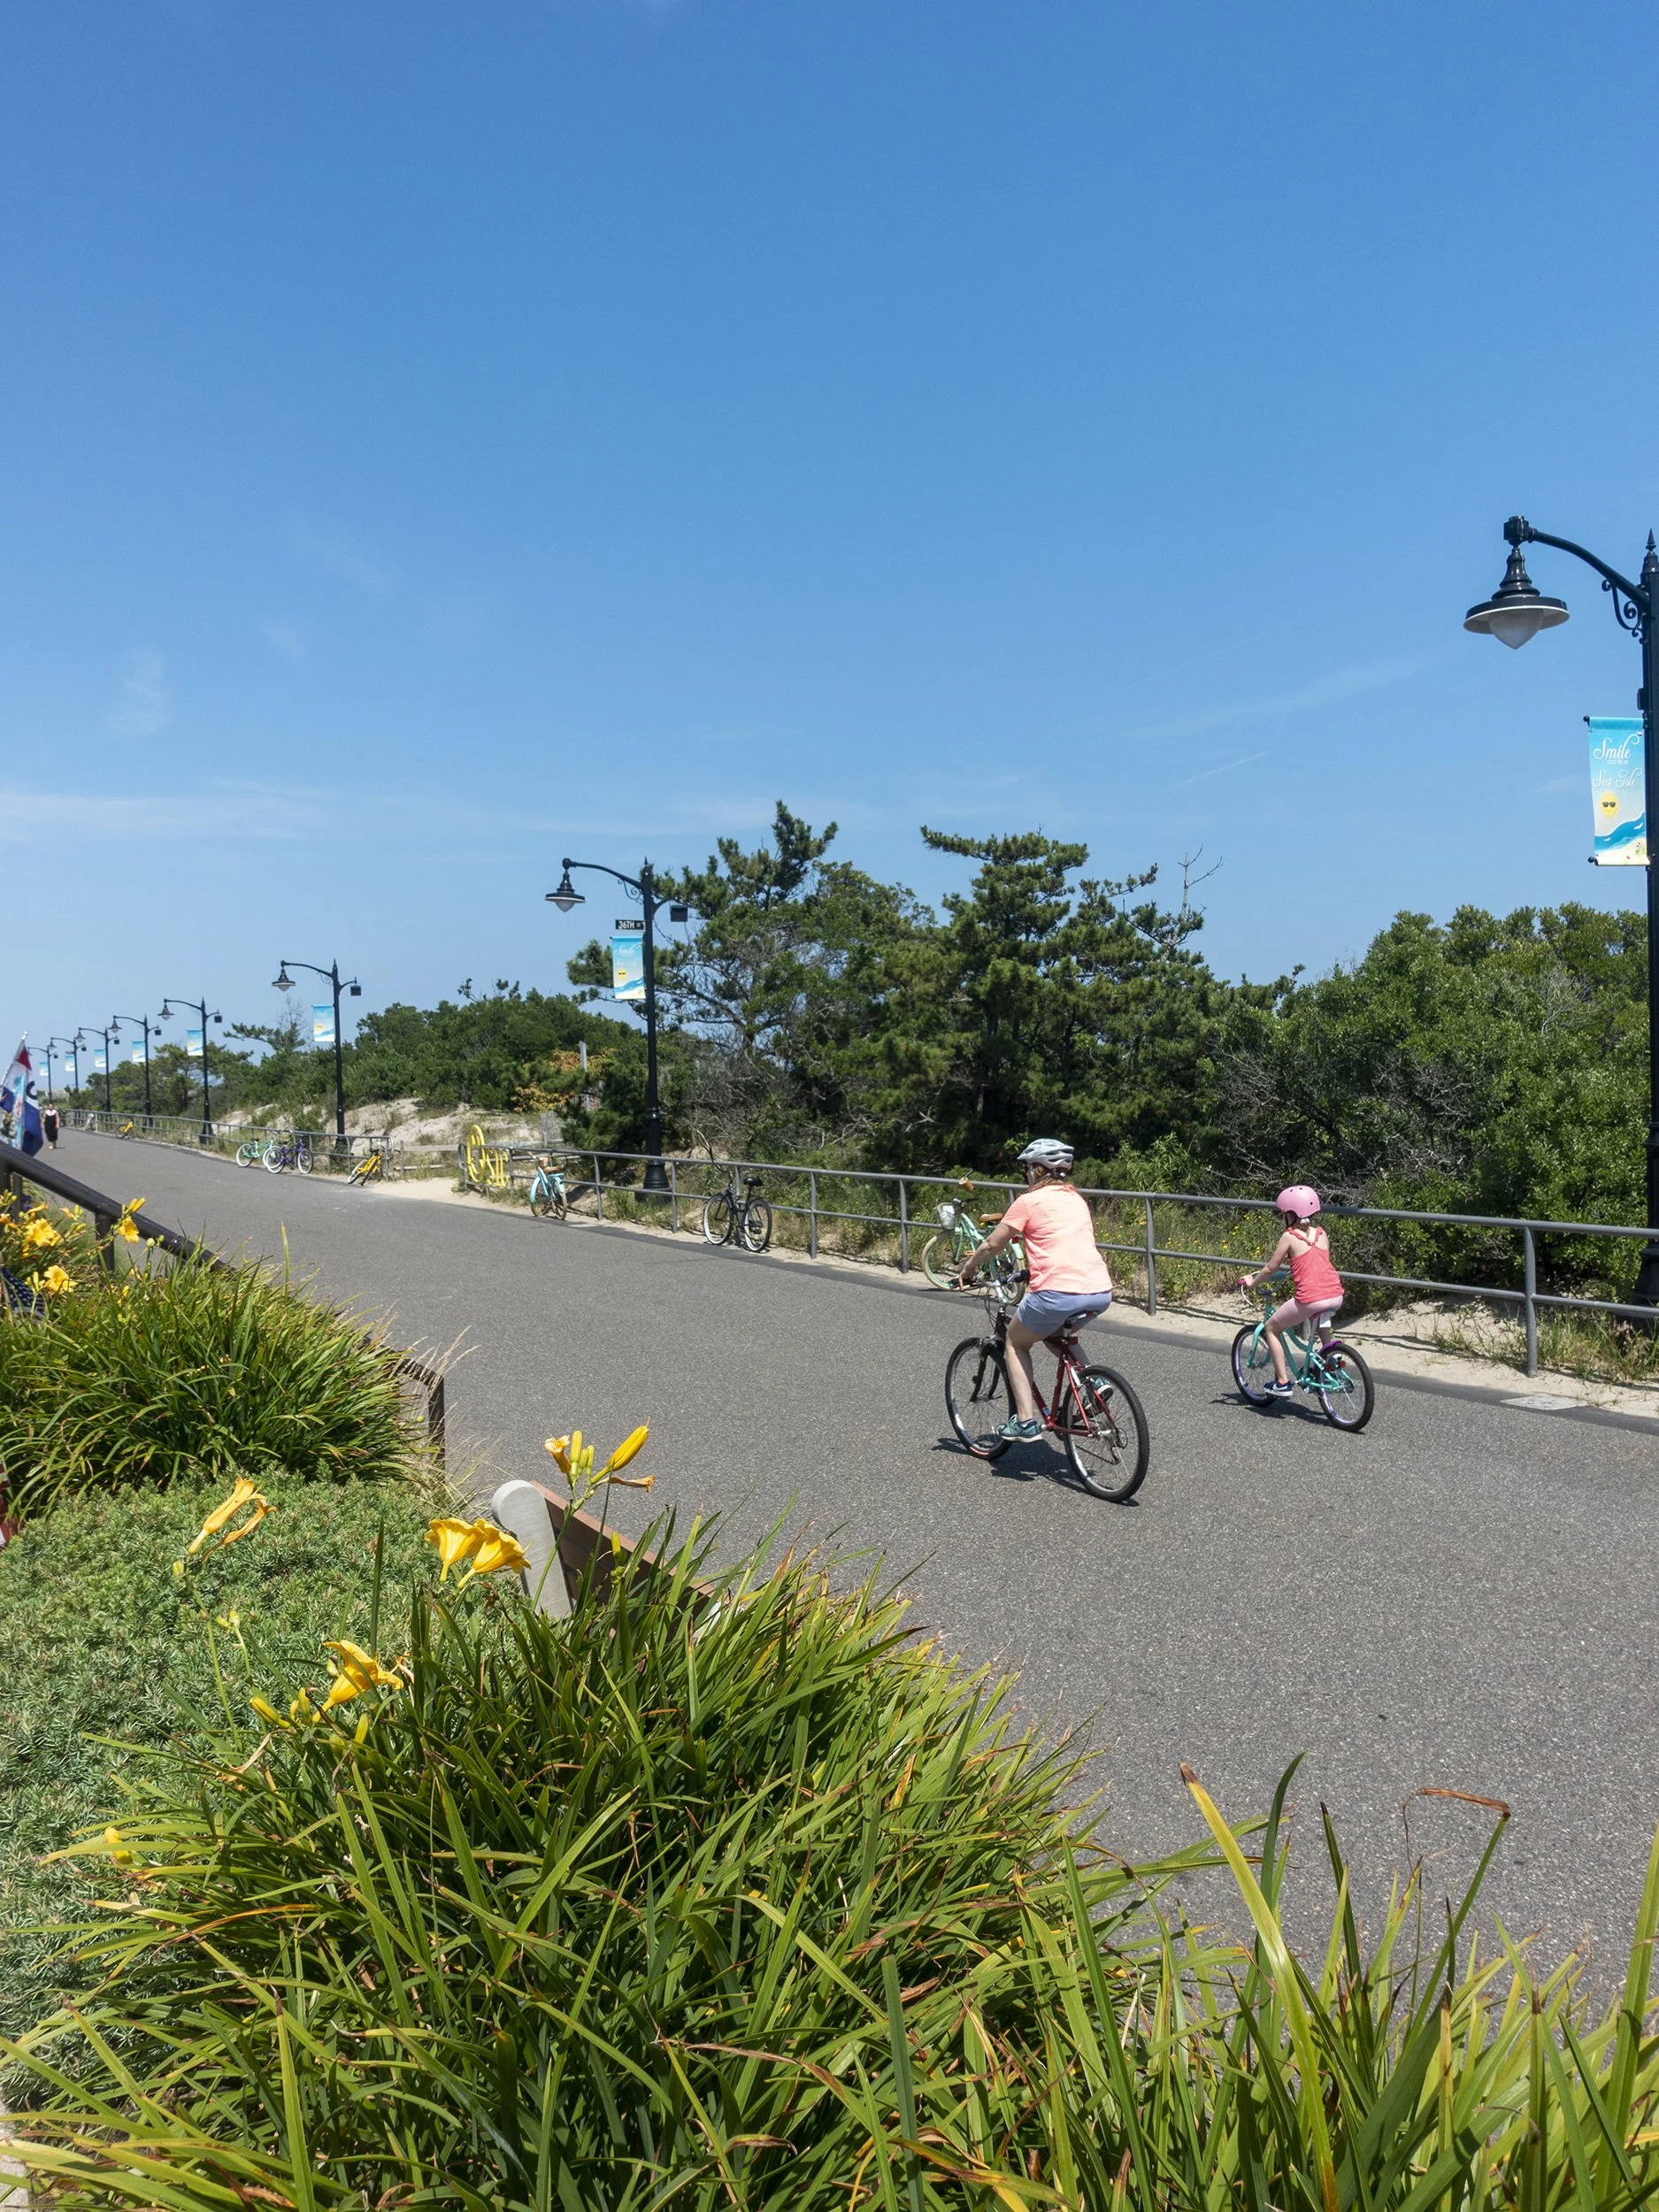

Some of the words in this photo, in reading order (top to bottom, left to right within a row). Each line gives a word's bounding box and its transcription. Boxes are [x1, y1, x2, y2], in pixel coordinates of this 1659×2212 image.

[1593, 733, 1640, 760] Smile
[1593, 771, 1613, 787] Sea
[618, 920, 635, 929] 36TH
